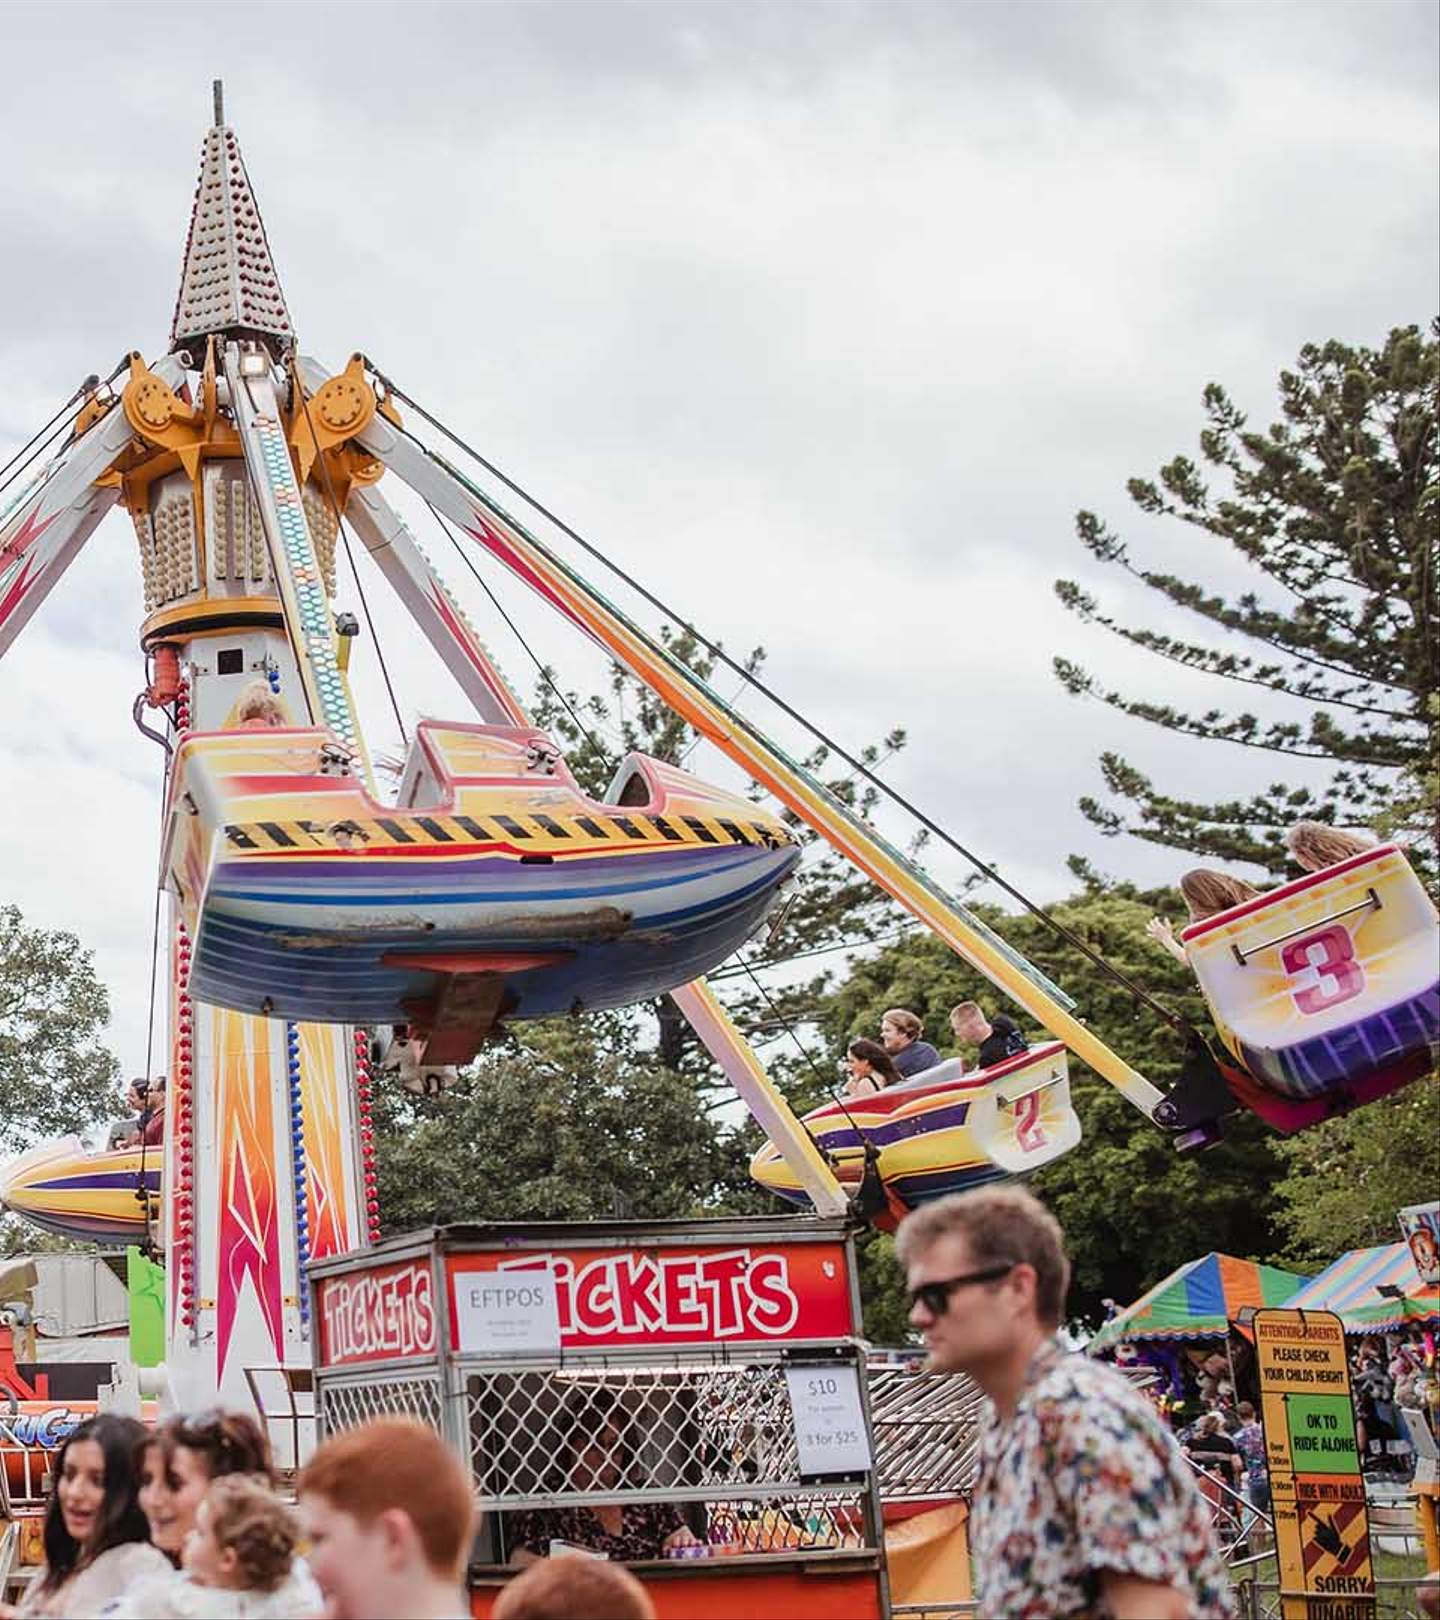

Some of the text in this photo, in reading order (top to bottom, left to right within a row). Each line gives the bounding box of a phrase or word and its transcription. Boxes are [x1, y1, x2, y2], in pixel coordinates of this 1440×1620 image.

[1280, 922, 1367, 1016] 3
[1013, 1089, 1049, 1153] 2
[470, 1287, 544, 1309] EFTPOS
[1272, 1347, 1331, 1363] PLEASE CHECK
[1263, 1367, 1344, 1384] YOUR CHILDS HEIGHT
[807, 1379, 838, 1396] $10
[1306, 1413, 1338, 1430] OK TO
[1294, 1436, 1356, 1453] RIDE ALONE
[1298, 1482, 1318, 1499] RIDE
[1318, 1483, 1339, 1500] WITH
[1314, 1575, 1367, 1593] SORRY
